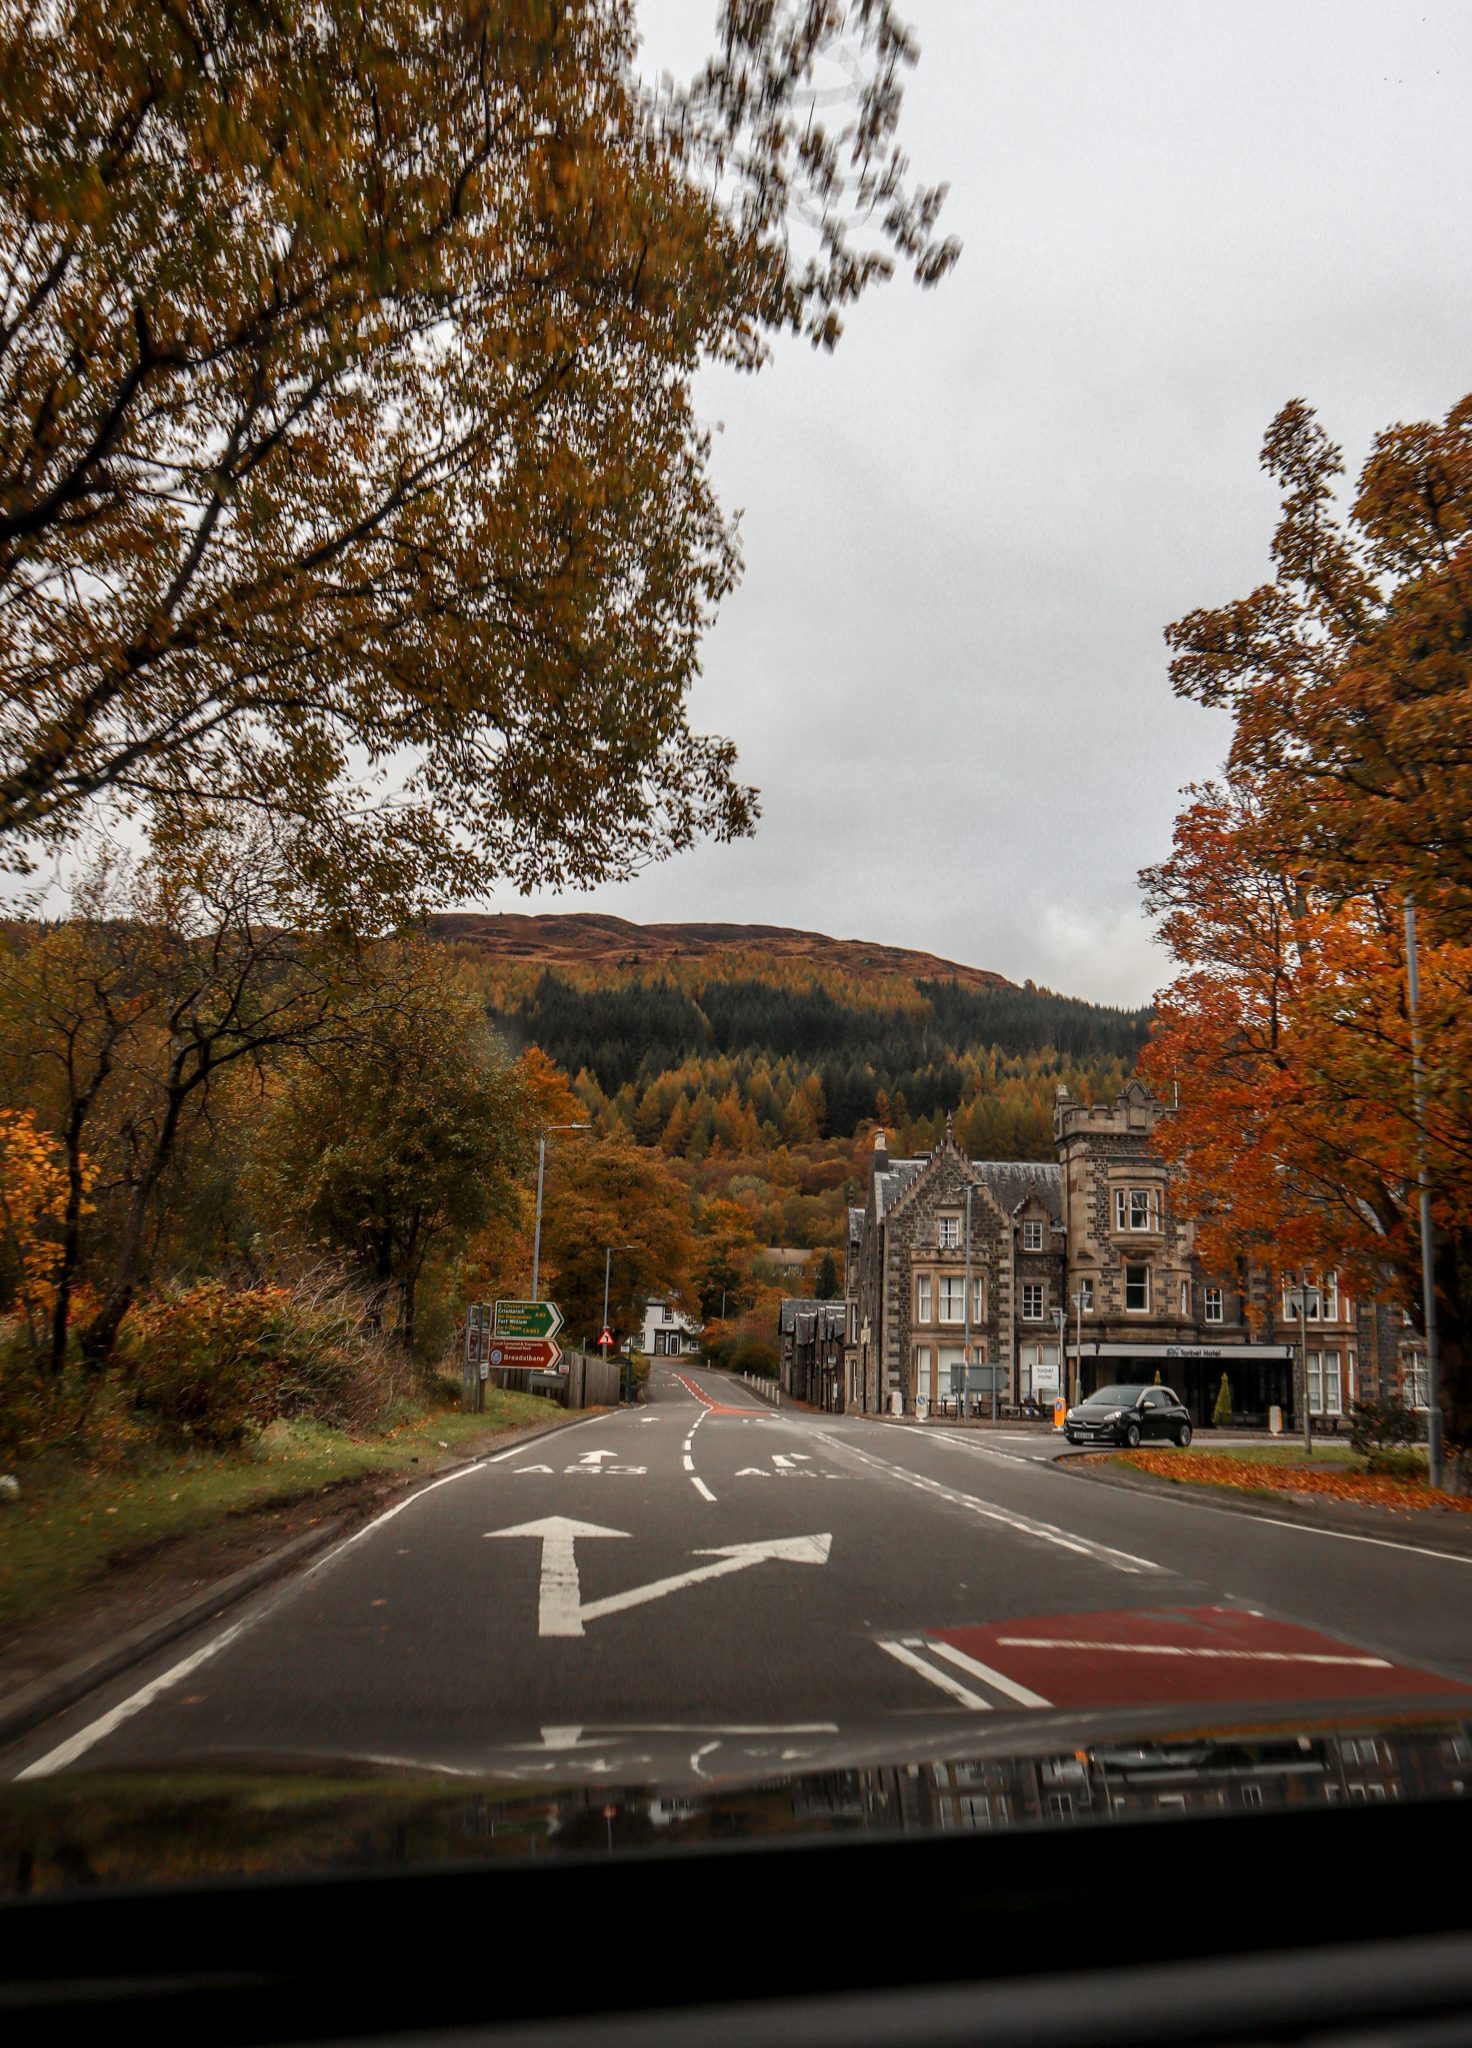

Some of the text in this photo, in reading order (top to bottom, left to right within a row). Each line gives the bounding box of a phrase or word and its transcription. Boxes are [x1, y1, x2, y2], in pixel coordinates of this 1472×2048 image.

[1180, 1349, 1202, 1357] Tarbet
[1203, 1349, 1221, 1357] Hotel
[503, 1354, 545, 1362] Breadalbane
